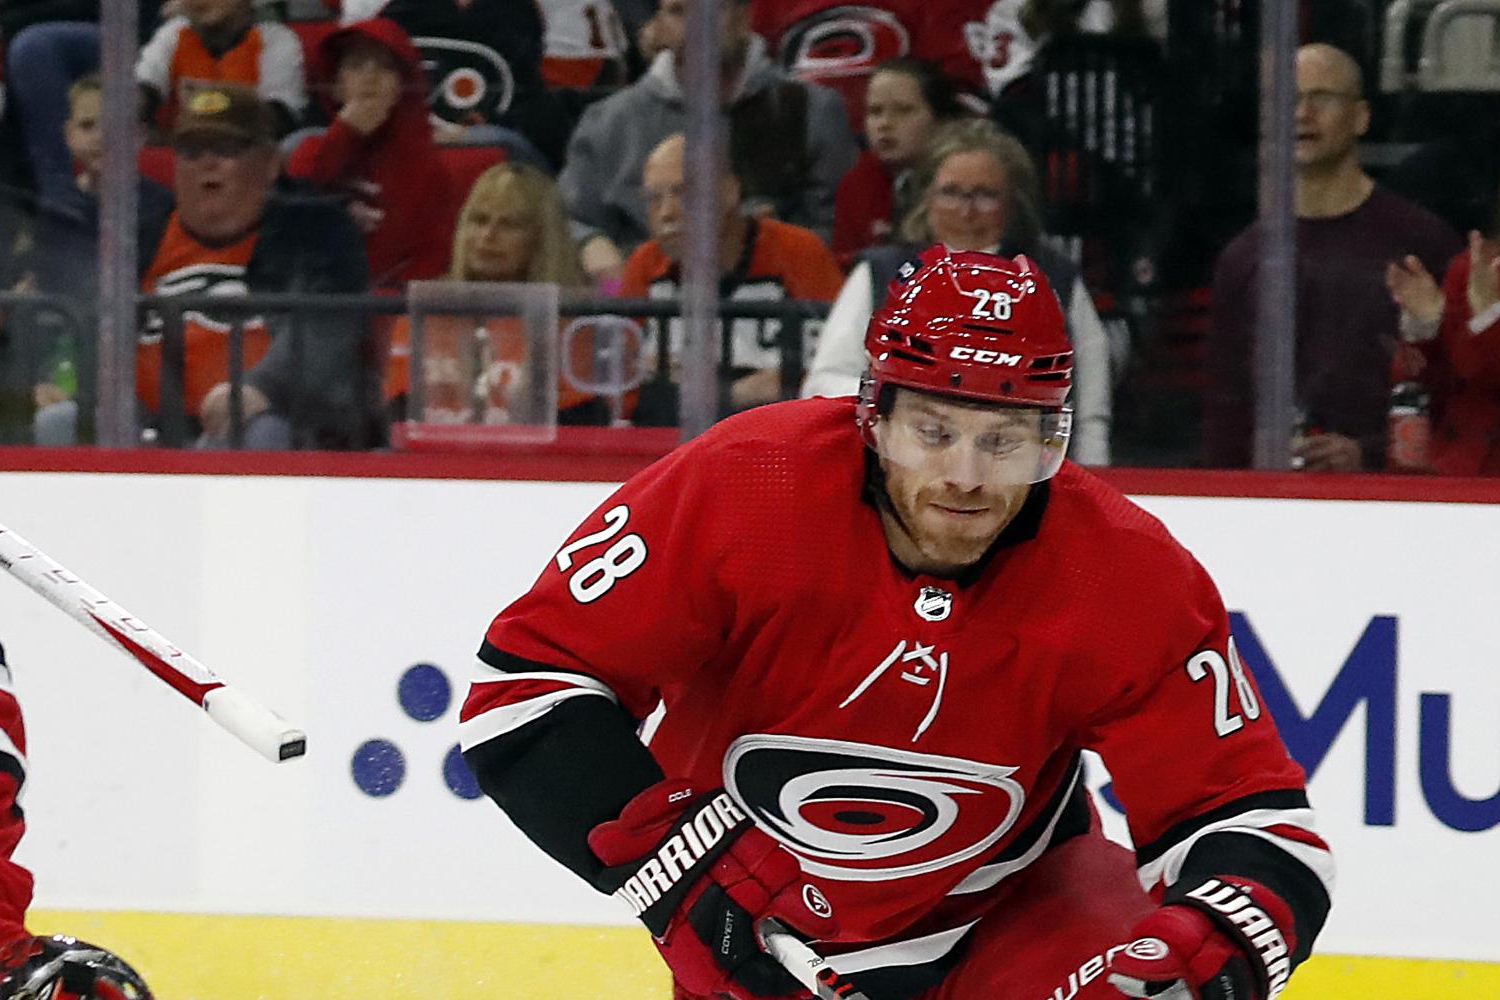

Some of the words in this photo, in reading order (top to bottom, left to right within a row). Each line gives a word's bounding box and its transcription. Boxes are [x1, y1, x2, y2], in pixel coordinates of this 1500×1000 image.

[971, 288, 1013, 321] 28
[949, 346, 1023, 367] CCM
[554, 503, 649, 605] 28
[1185, 634, 1261, 738] 28
[721, 909, 735, 956] COVERT
